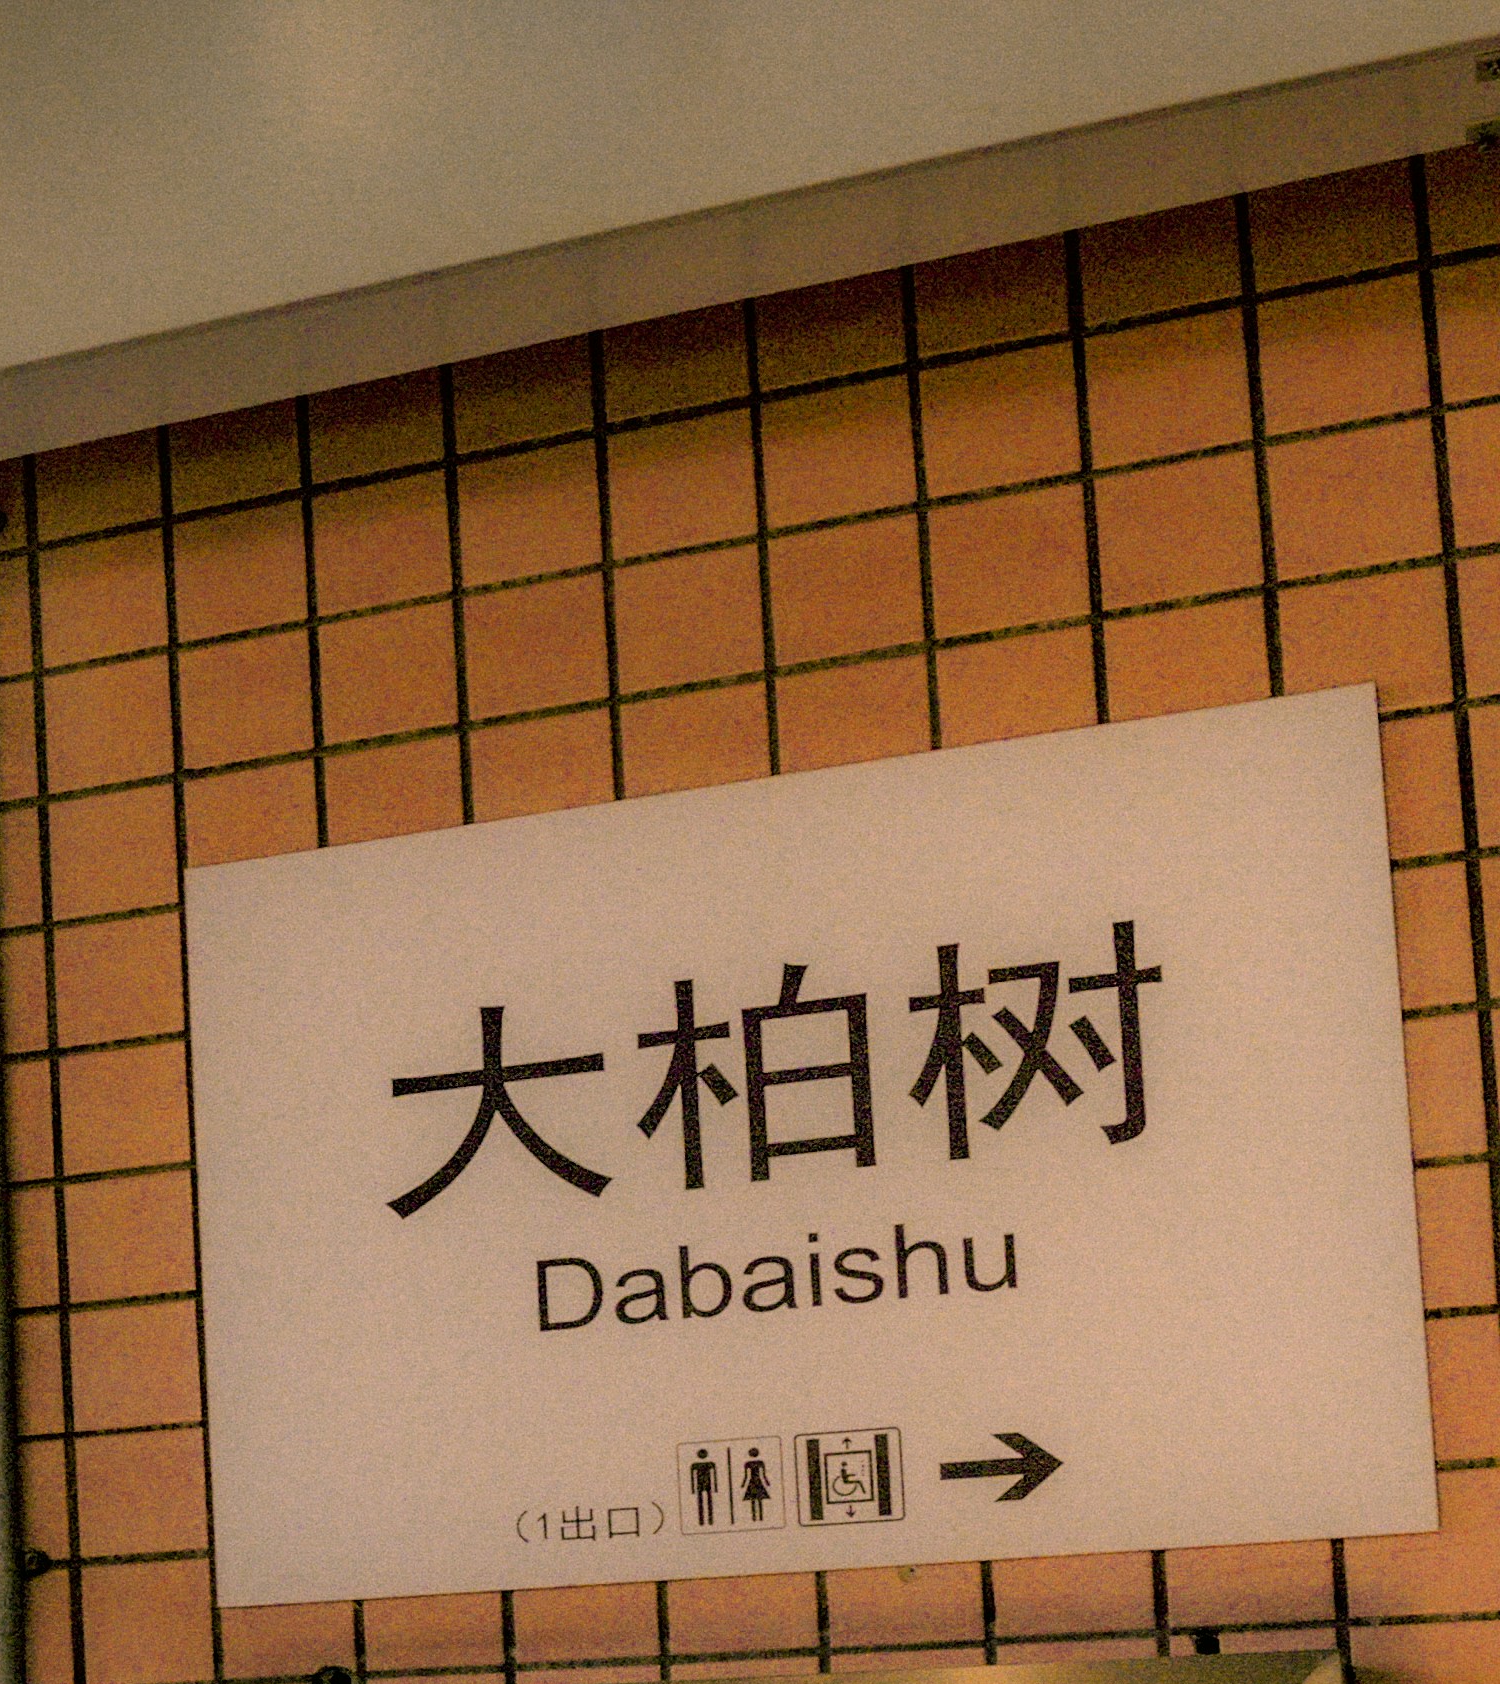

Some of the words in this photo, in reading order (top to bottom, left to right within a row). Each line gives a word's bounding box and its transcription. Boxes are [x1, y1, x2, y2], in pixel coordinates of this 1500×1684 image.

[386, 920, 1163, 1220] 大柏树
[537, 1223, 1019, 1332] Dabaishu
